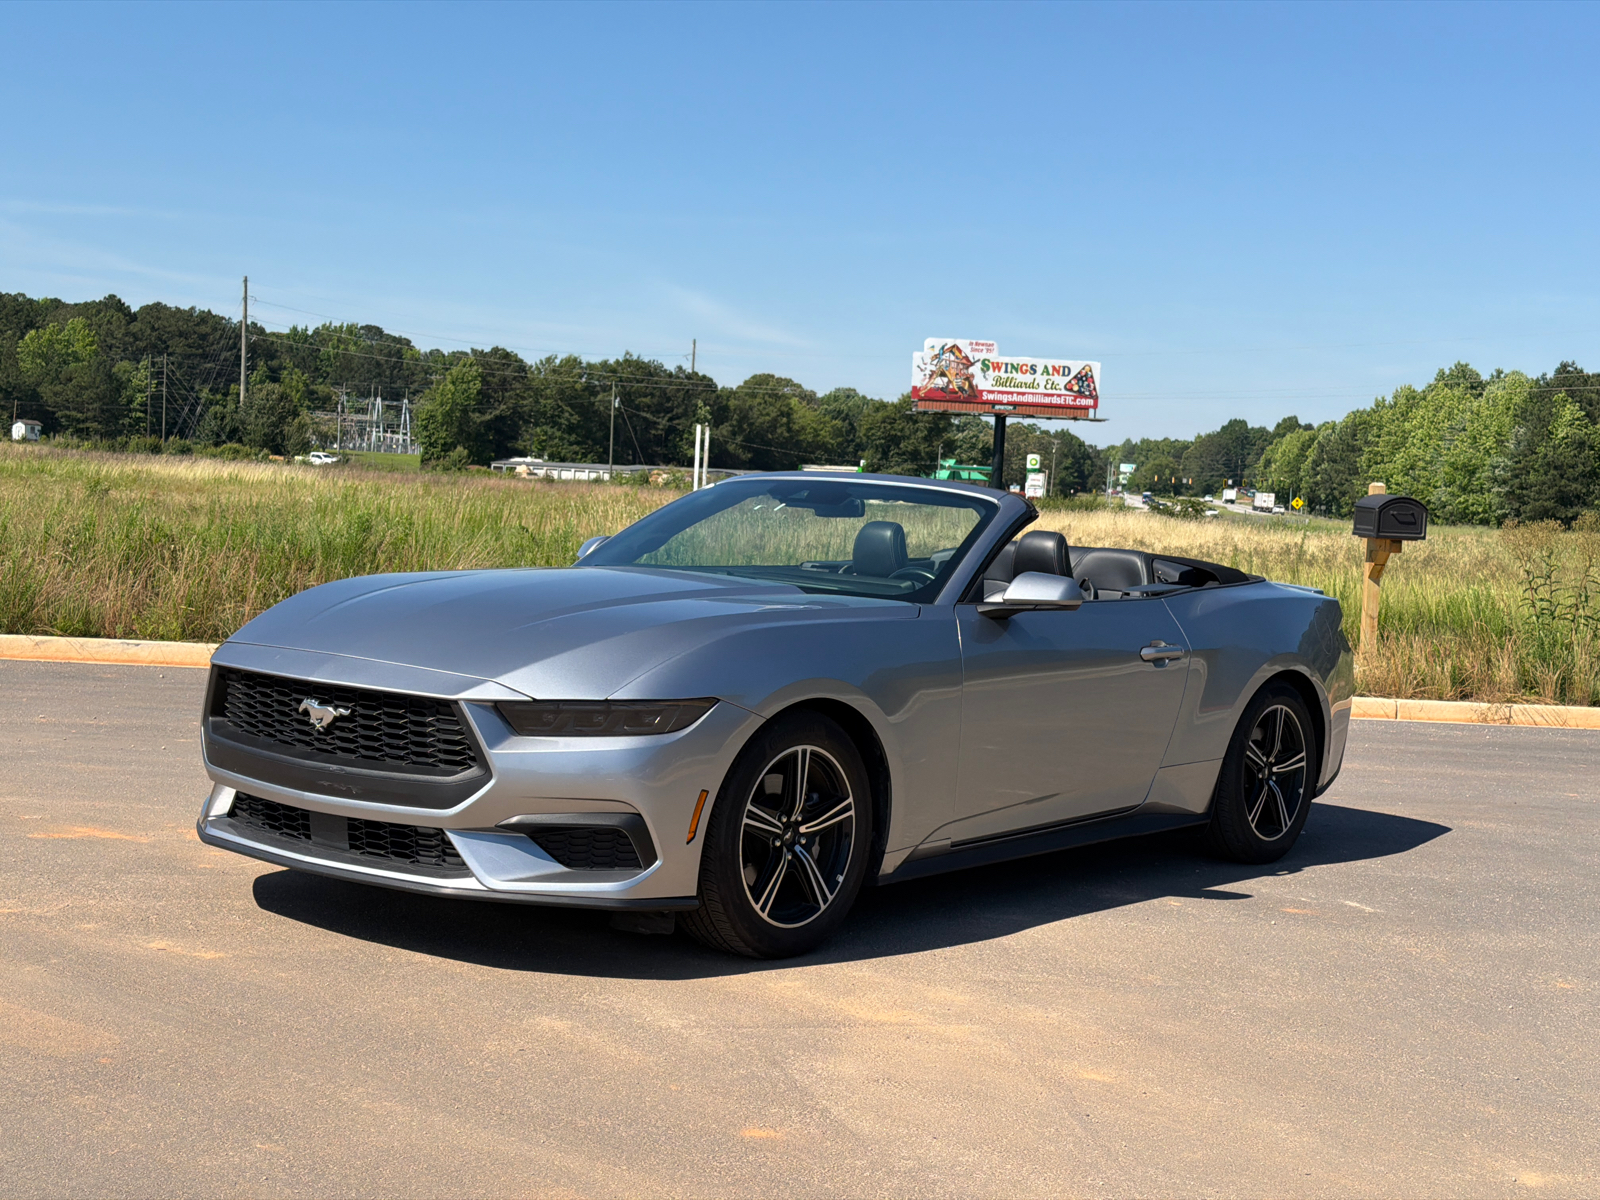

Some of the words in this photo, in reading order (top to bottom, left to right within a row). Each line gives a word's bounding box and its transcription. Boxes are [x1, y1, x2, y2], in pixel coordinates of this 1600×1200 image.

[981, 358, 1037, 375] SWINGS
[1041, 365, 1071, 377] AND
[991, 375, 1040, 390] Billiards
[1044, 378, 1062, 391] Etc.
[982, 391, 1094, 406] SwingsAndBilliardsETC.com
